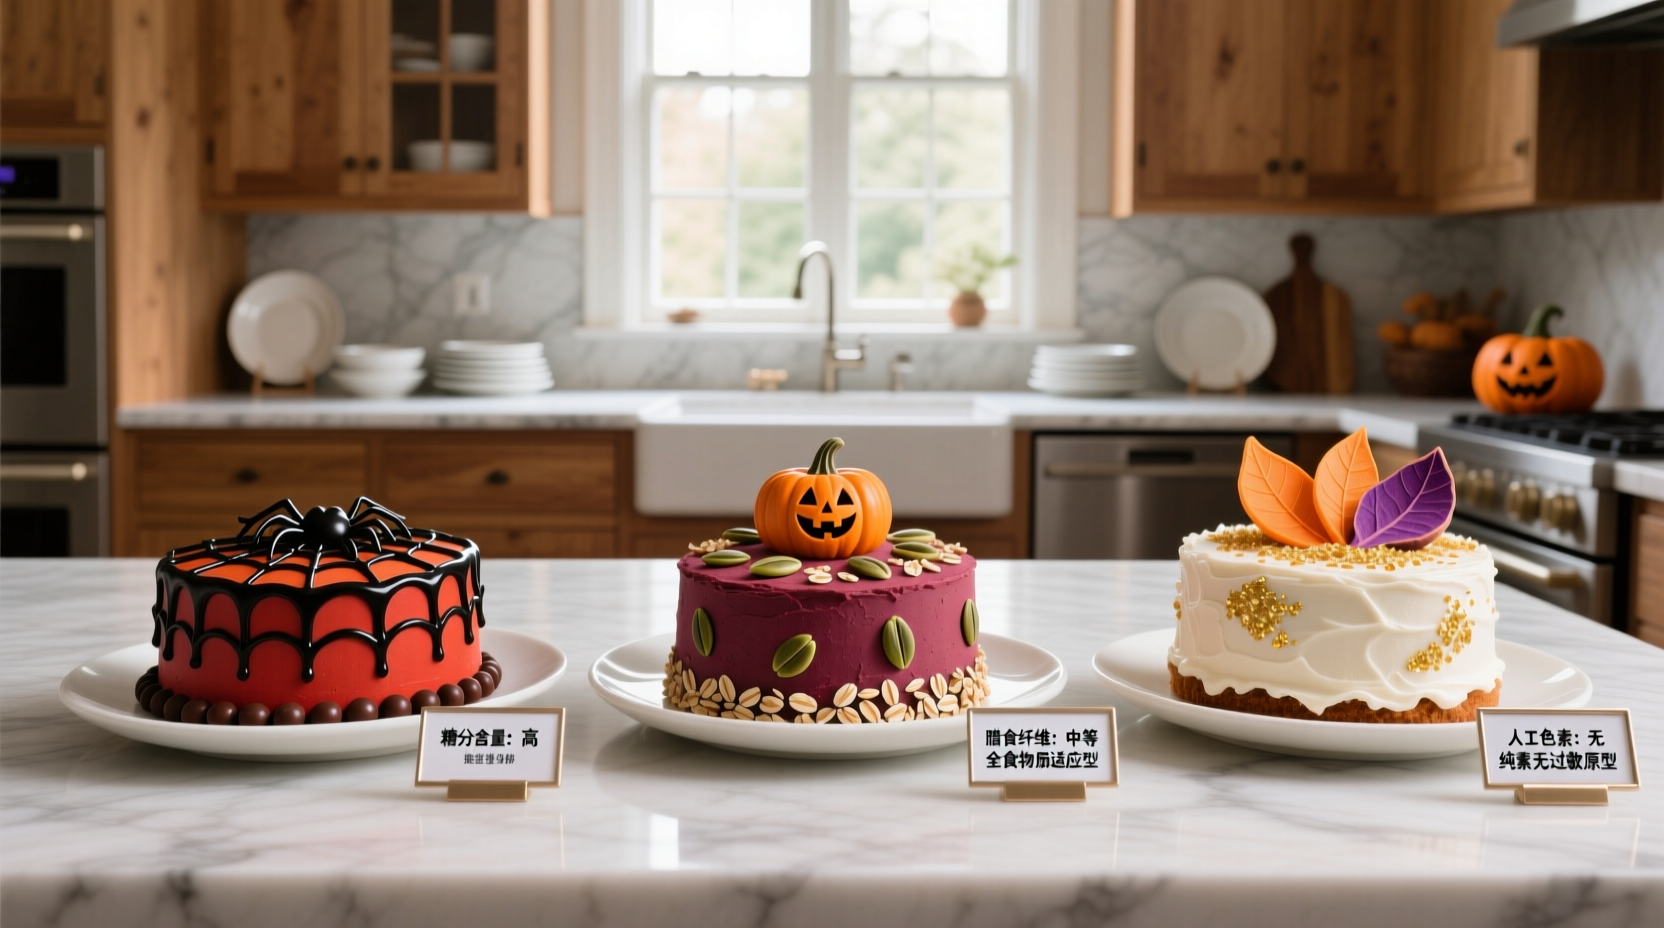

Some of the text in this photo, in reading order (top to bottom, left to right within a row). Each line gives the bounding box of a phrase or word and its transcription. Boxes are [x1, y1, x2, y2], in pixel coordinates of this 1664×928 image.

[1508, 727, 1606, 747] 人工色素：无
